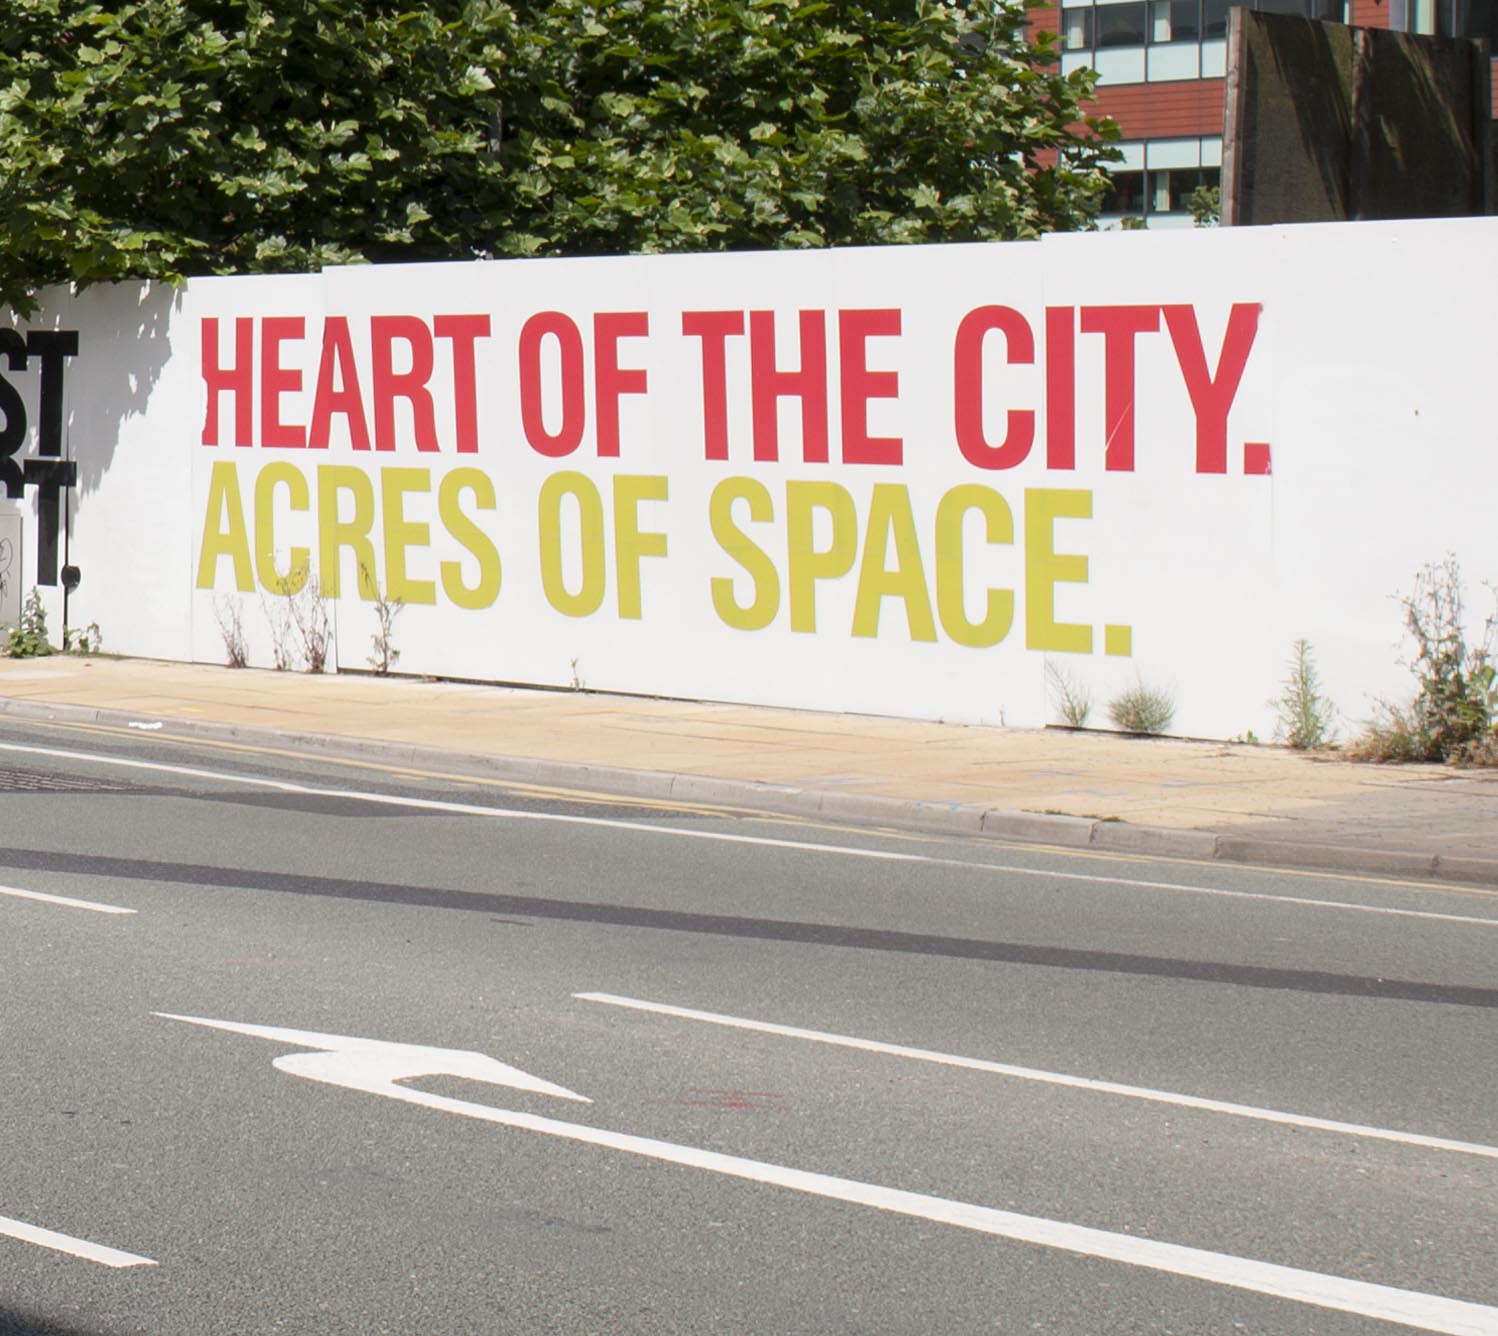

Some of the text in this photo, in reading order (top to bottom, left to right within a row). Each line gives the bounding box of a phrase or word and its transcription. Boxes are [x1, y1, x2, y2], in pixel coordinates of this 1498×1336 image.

[201, 302, 1272, 475] HEART OF THE CITY.
[195, 460, 1133, 657] ACRES OF SPACE.
